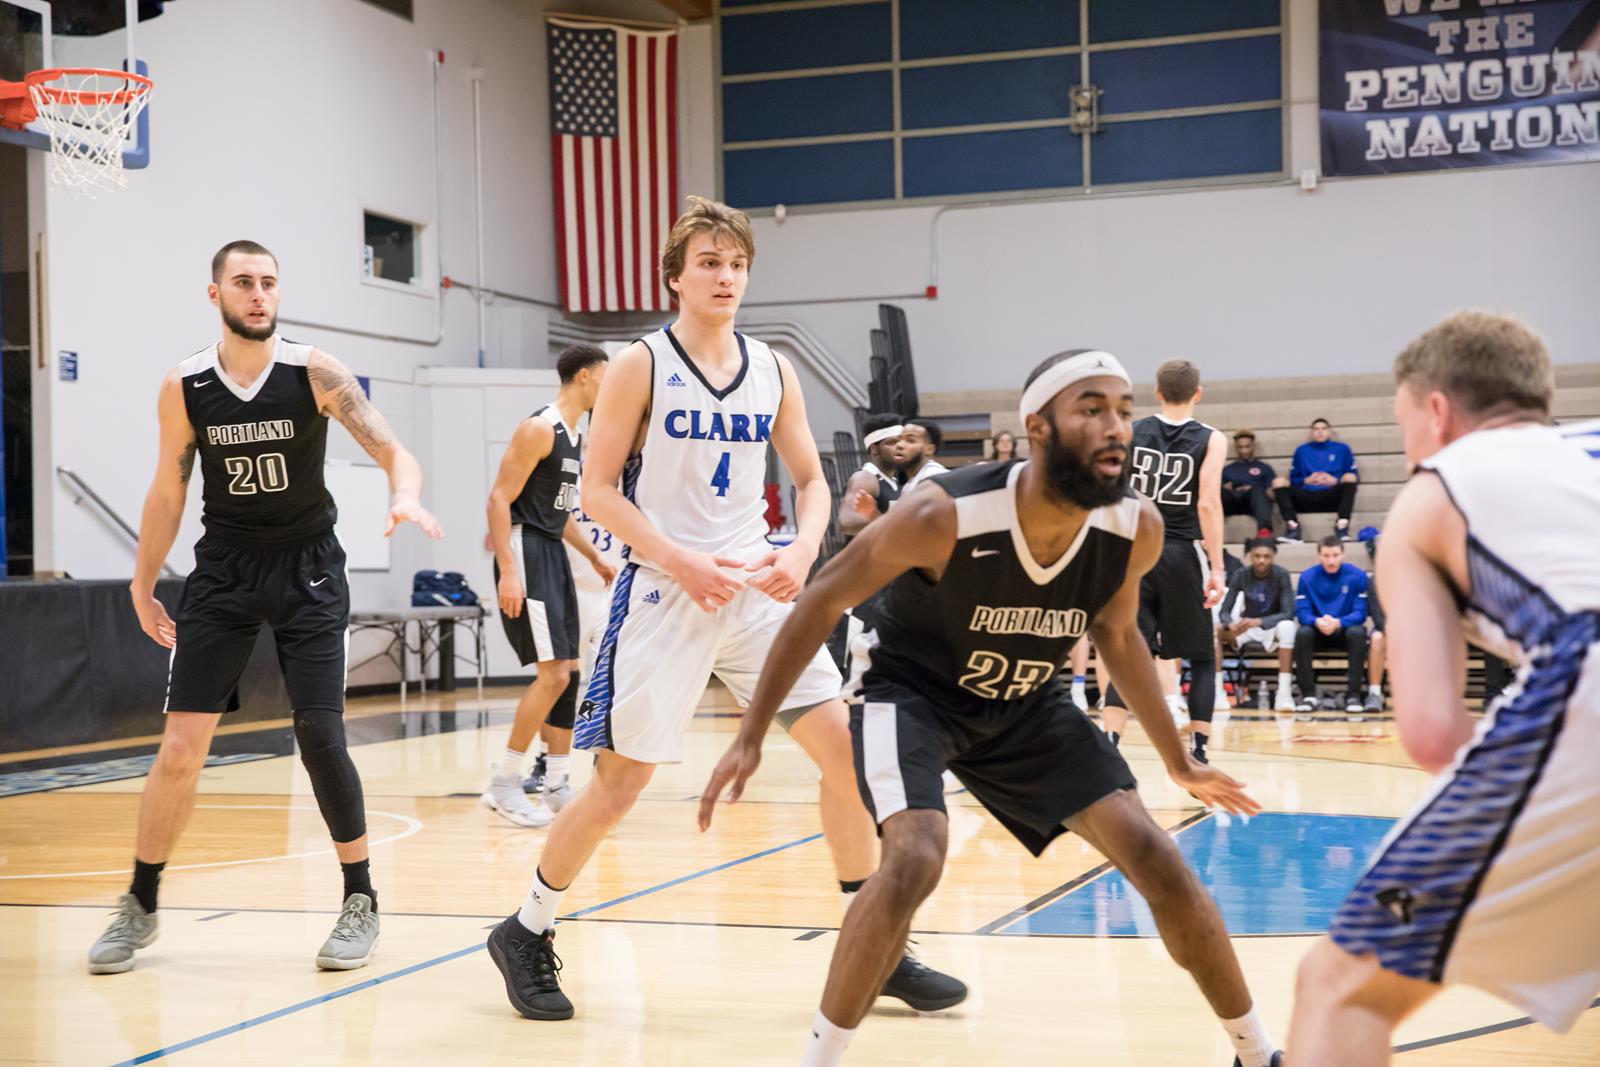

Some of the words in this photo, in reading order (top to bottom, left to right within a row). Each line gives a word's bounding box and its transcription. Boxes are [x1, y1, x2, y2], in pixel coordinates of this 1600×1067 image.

[1428, 13, 1535, 55] THE
[1365, 101, 1600, 160] NATION
[206, 419, 294, 445] PORTLAND
[664, 409, 772, 443] CLARK
[224, 452, 289, 495] 20
[710, 452, 731, 497] 4
[1129, 446, 1195, 506] 32
[969, 605, 1088, 639] PORTLAND
